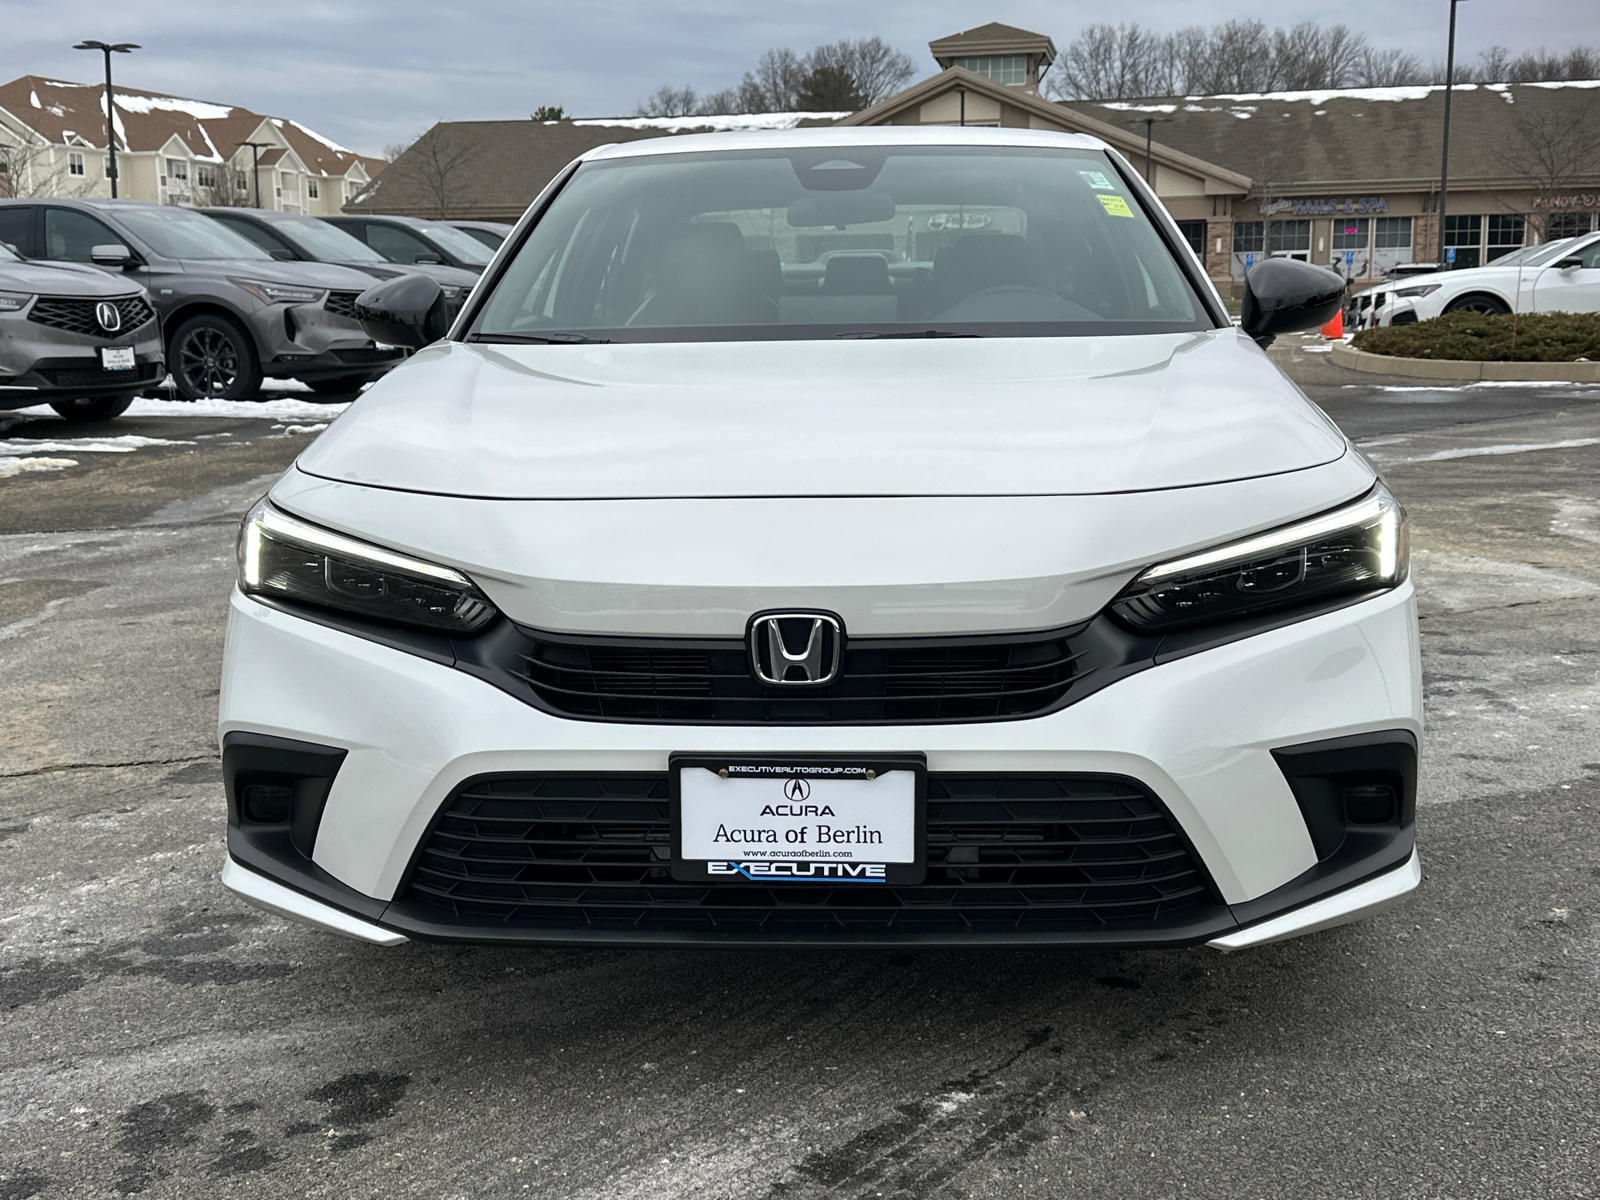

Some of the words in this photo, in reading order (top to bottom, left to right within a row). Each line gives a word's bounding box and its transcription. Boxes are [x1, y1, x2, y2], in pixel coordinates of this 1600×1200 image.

[1292, 199, 1338, 214] NAILS
[1344, 198, 1355, 213] &
[1358, 197, 1387, 212] SPA
[728, 765, 867, 775] EXECUTIVEAUTOGROUP.COM
[759, 804, 836, 817] ACURA
[712, 823, 779, 844] Acura
[785, 826, 808, 844] of
[816, 824, 884, 844] Berlin
[743, 849, 853, 859] www.acuraofberlin.com
[707, 861, 886, 878] EXECUTIVE
